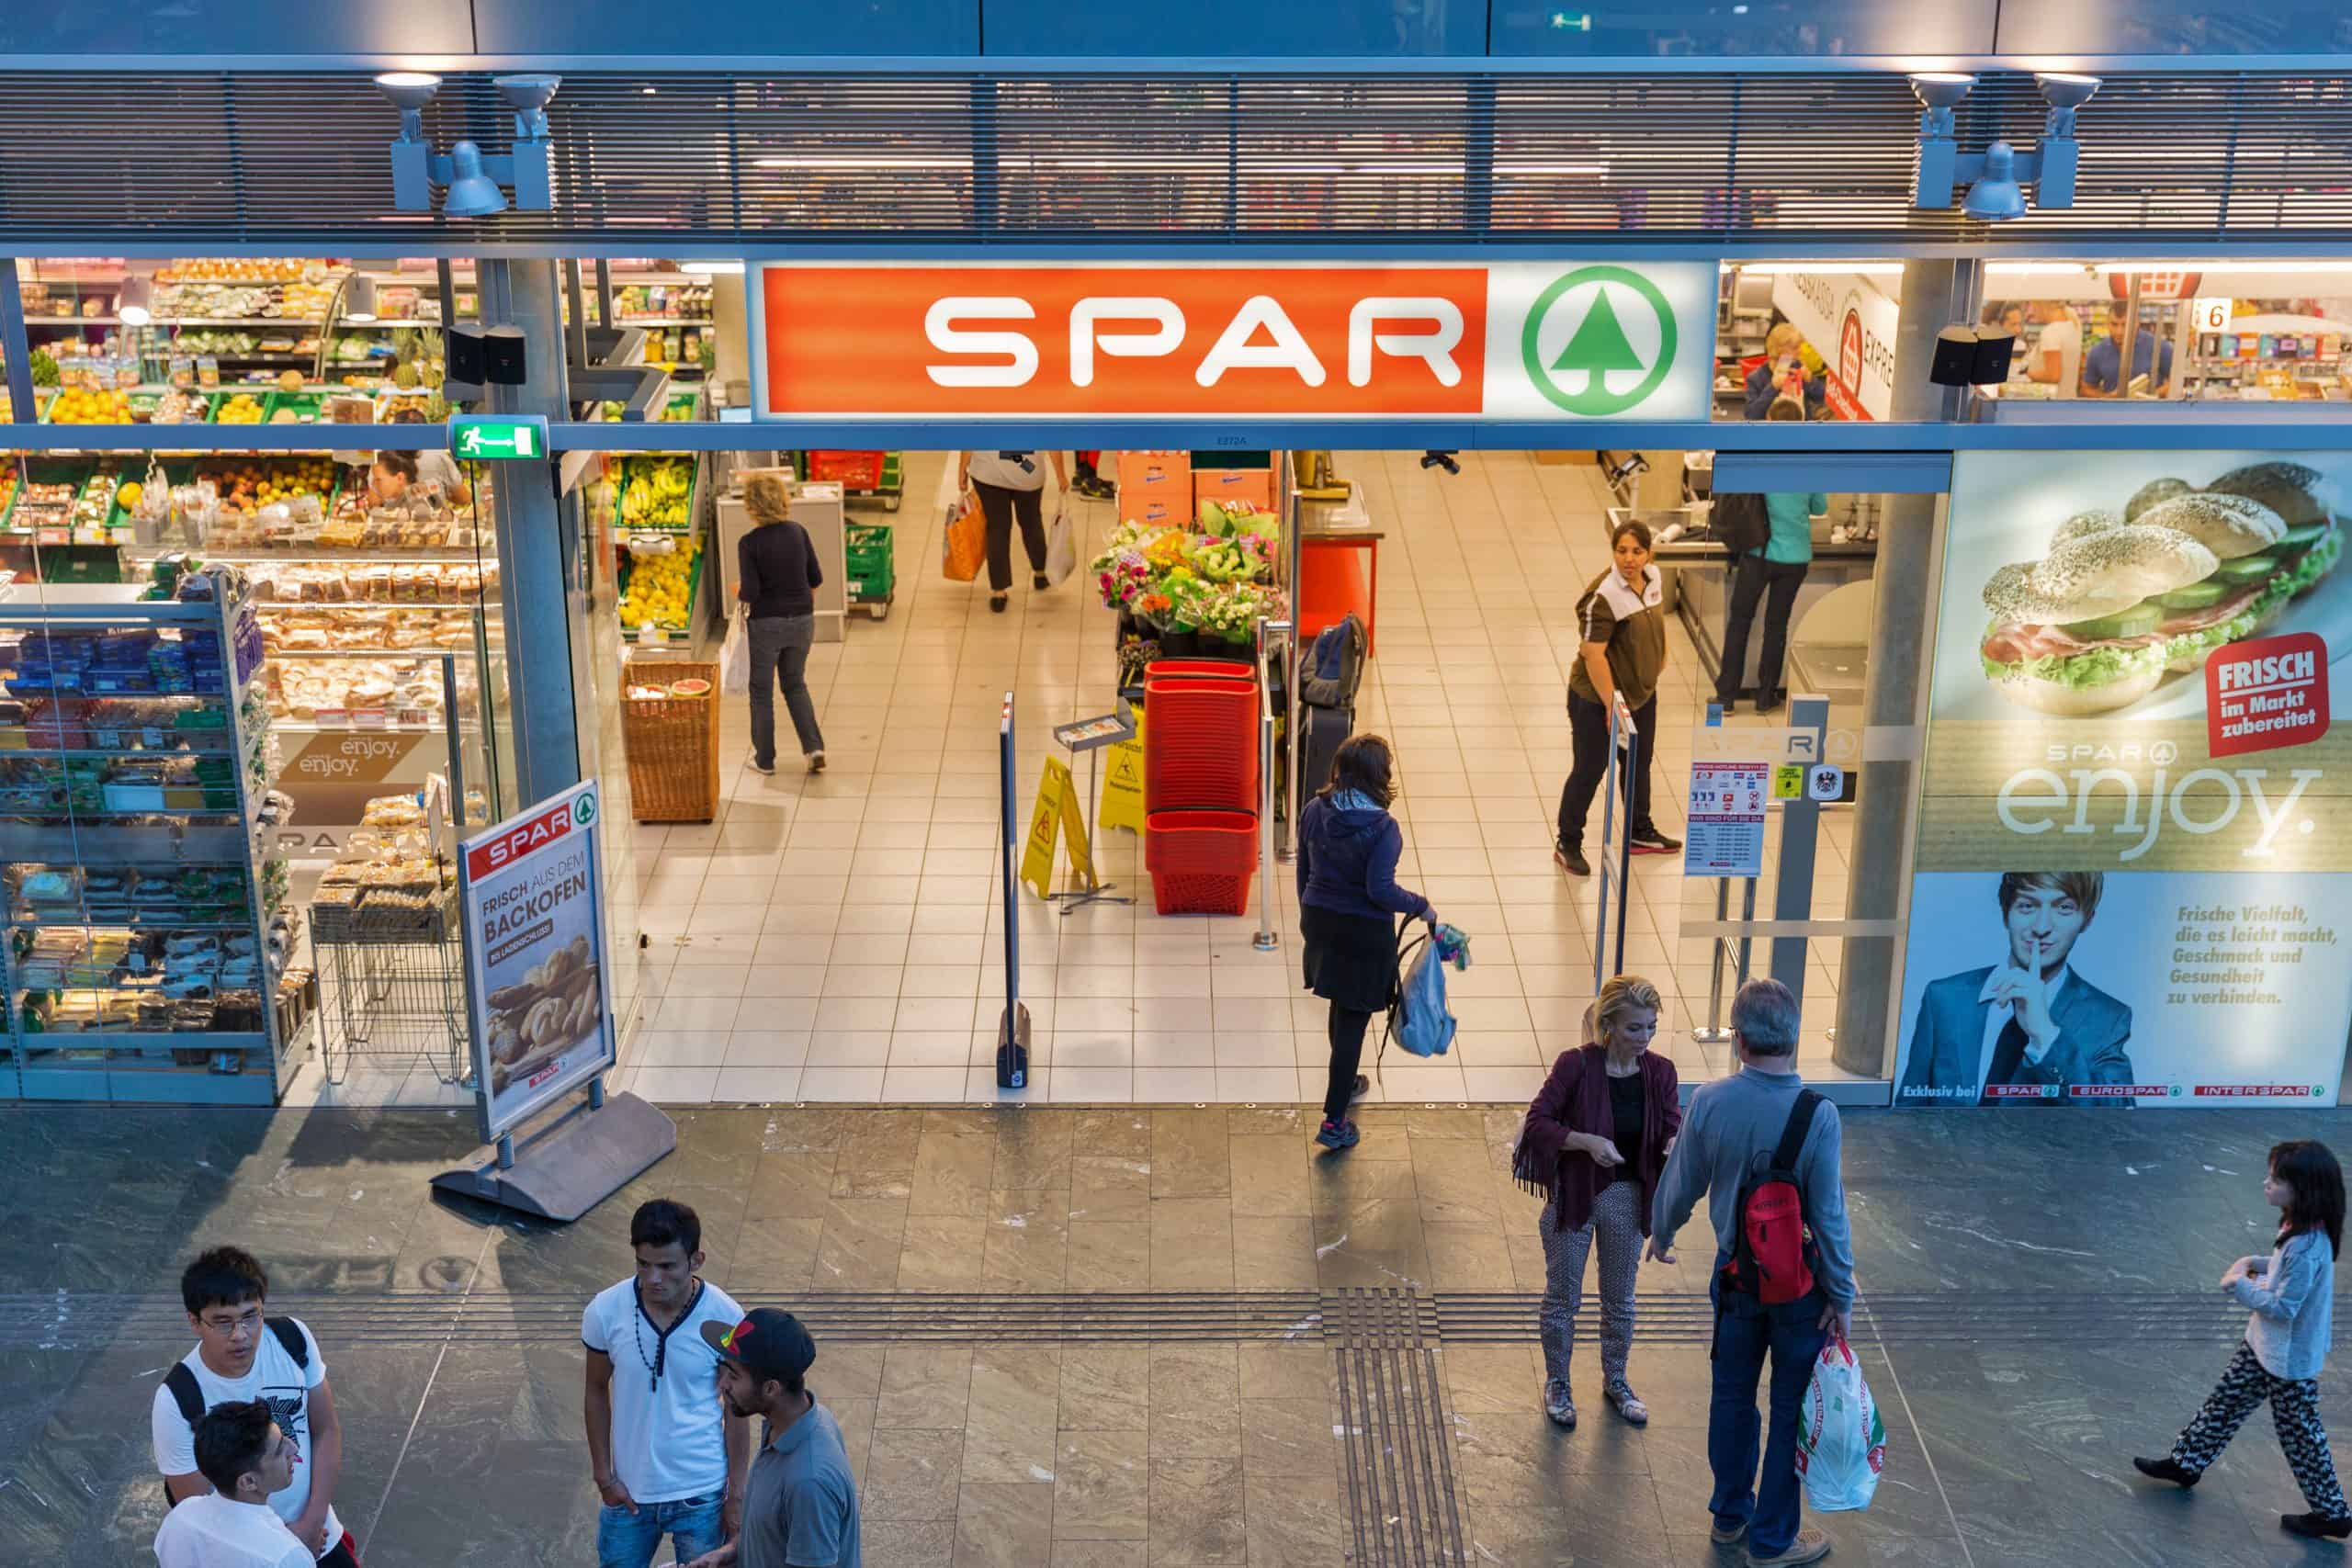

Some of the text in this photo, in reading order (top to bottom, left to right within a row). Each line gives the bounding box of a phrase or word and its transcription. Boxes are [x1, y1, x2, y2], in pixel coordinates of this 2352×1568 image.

[2209, 305, 2224, 328] 6
[924, 295, 1464, 388] SPAR
[2218, 650, 2315, 691] FRISCH
[2221, 690, 2305, 718] im Markt
[2222, 708, 2316, 739] zubereitet
[2045, 743, 2143, 761] SPAR
[300, 755, 359, 777] enjoy.
[1996, 768, 2324, 862] enjoy.
[489, 810, 569, 866] SPAR
[482, 850, 585, 918] FRISCH AUS DEM
[484, 870, 586, 944] BACKOFEN
[2177, 905, 2309, 924] Frische Vielfalt,
[2175, 926, 2338, 945] die es leicht macht,
[2172, 947, 2303, 964] Geschmack und
[2169, 967, 2265, 984] Gesundheit
[2166, 988, 2282, 1004] zu verbinden.
[1903, 1084, 1975, 1098] Exklusiv bei
[1996, 1087, 2042, 1096] SPAR
[2079, 1086, 2168, 1096] EUROSPAR
[2202, 1086, 2310, 1096] INTERSPAR
